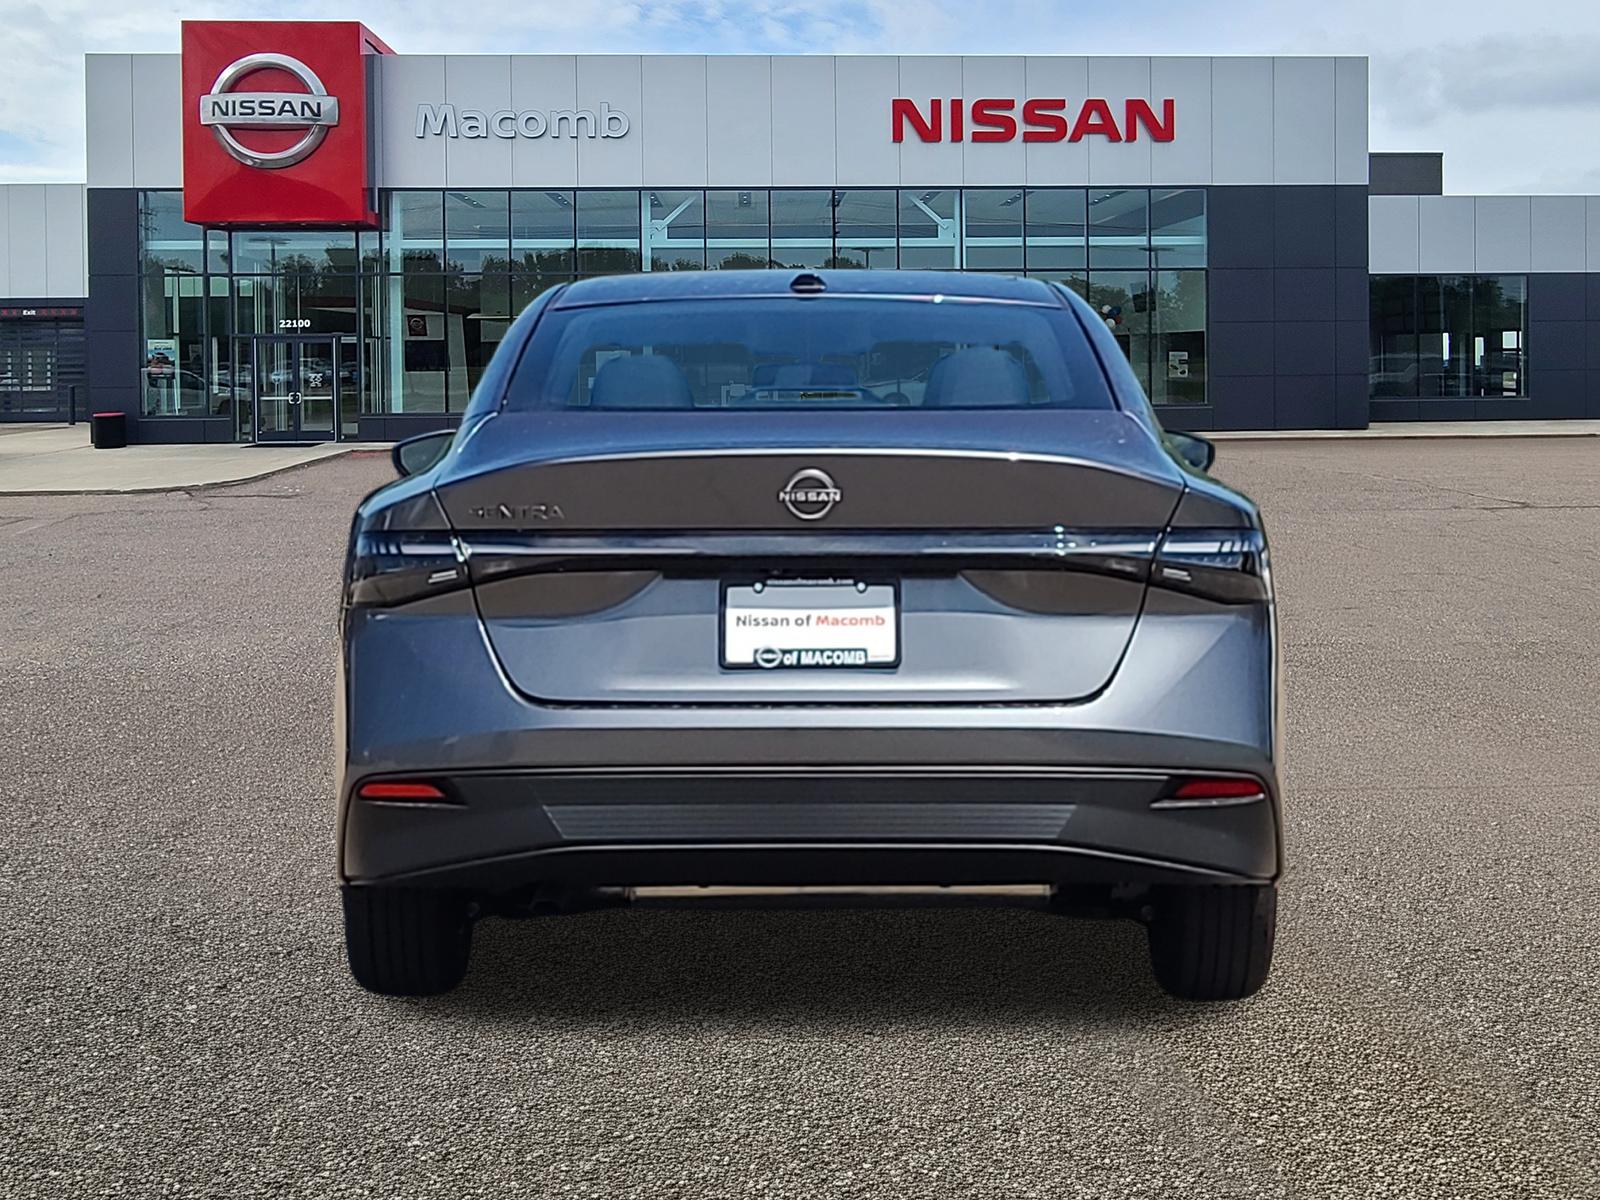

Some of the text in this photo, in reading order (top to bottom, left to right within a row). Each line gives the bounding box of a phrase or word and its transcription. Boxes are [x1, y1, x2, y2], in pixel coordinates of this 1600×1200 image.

[212, 100, 322, 117] NISSAN
[415, 102, 630, 139] Macomb
[892, 98, 1176, 143] NISSAN
[279, 319, 311, 328] 22100
[779, 490, 841, 502] NISSAN
[467, 504, 565, 520] ENTRA
[735, 614, 886, 627] Nissan of Macomb
[782, 651, 798, 665] of
[800, 650, 867, 665] MACOMB
